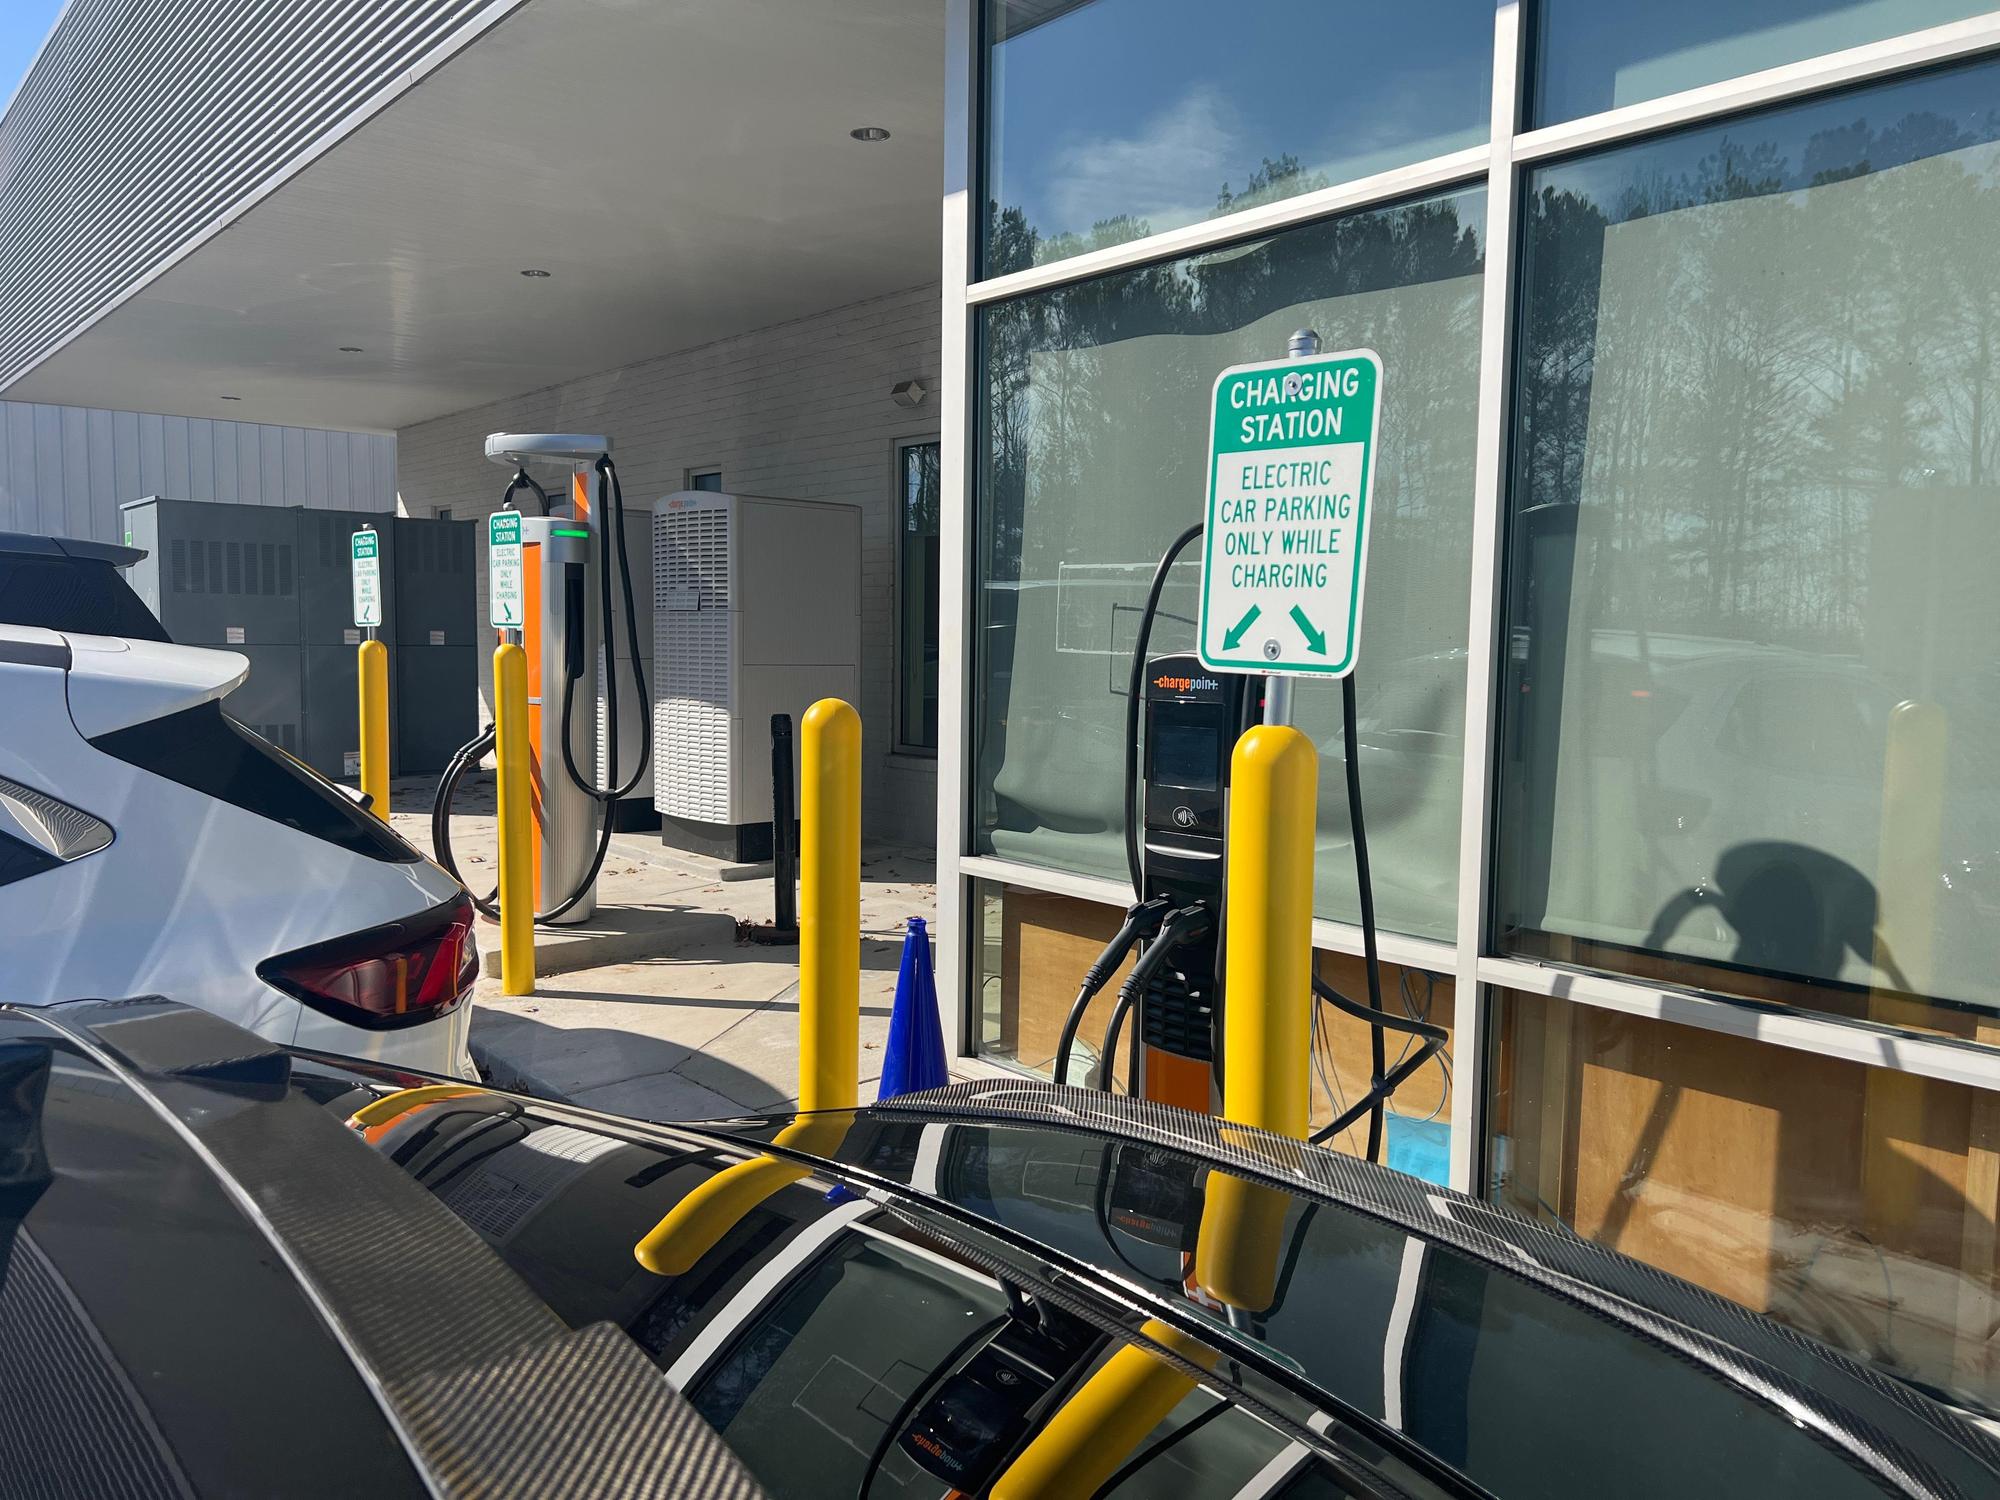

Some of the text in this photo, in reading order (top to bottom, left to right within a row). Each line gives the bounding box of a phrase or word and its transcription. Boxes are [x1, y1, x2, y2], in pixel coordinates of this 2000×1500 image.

[1240, 407, 1343, 444] STATION
[1242, 461, 1331, 490] ELECTRIC
[1221, 494, 1351, 523] CAR PARKING
[495, 531, 515, 542] STATION
[1225, 529, 1341, 555] ONLY WHILE
[1232, 564, 1327, 588] CHARGING
